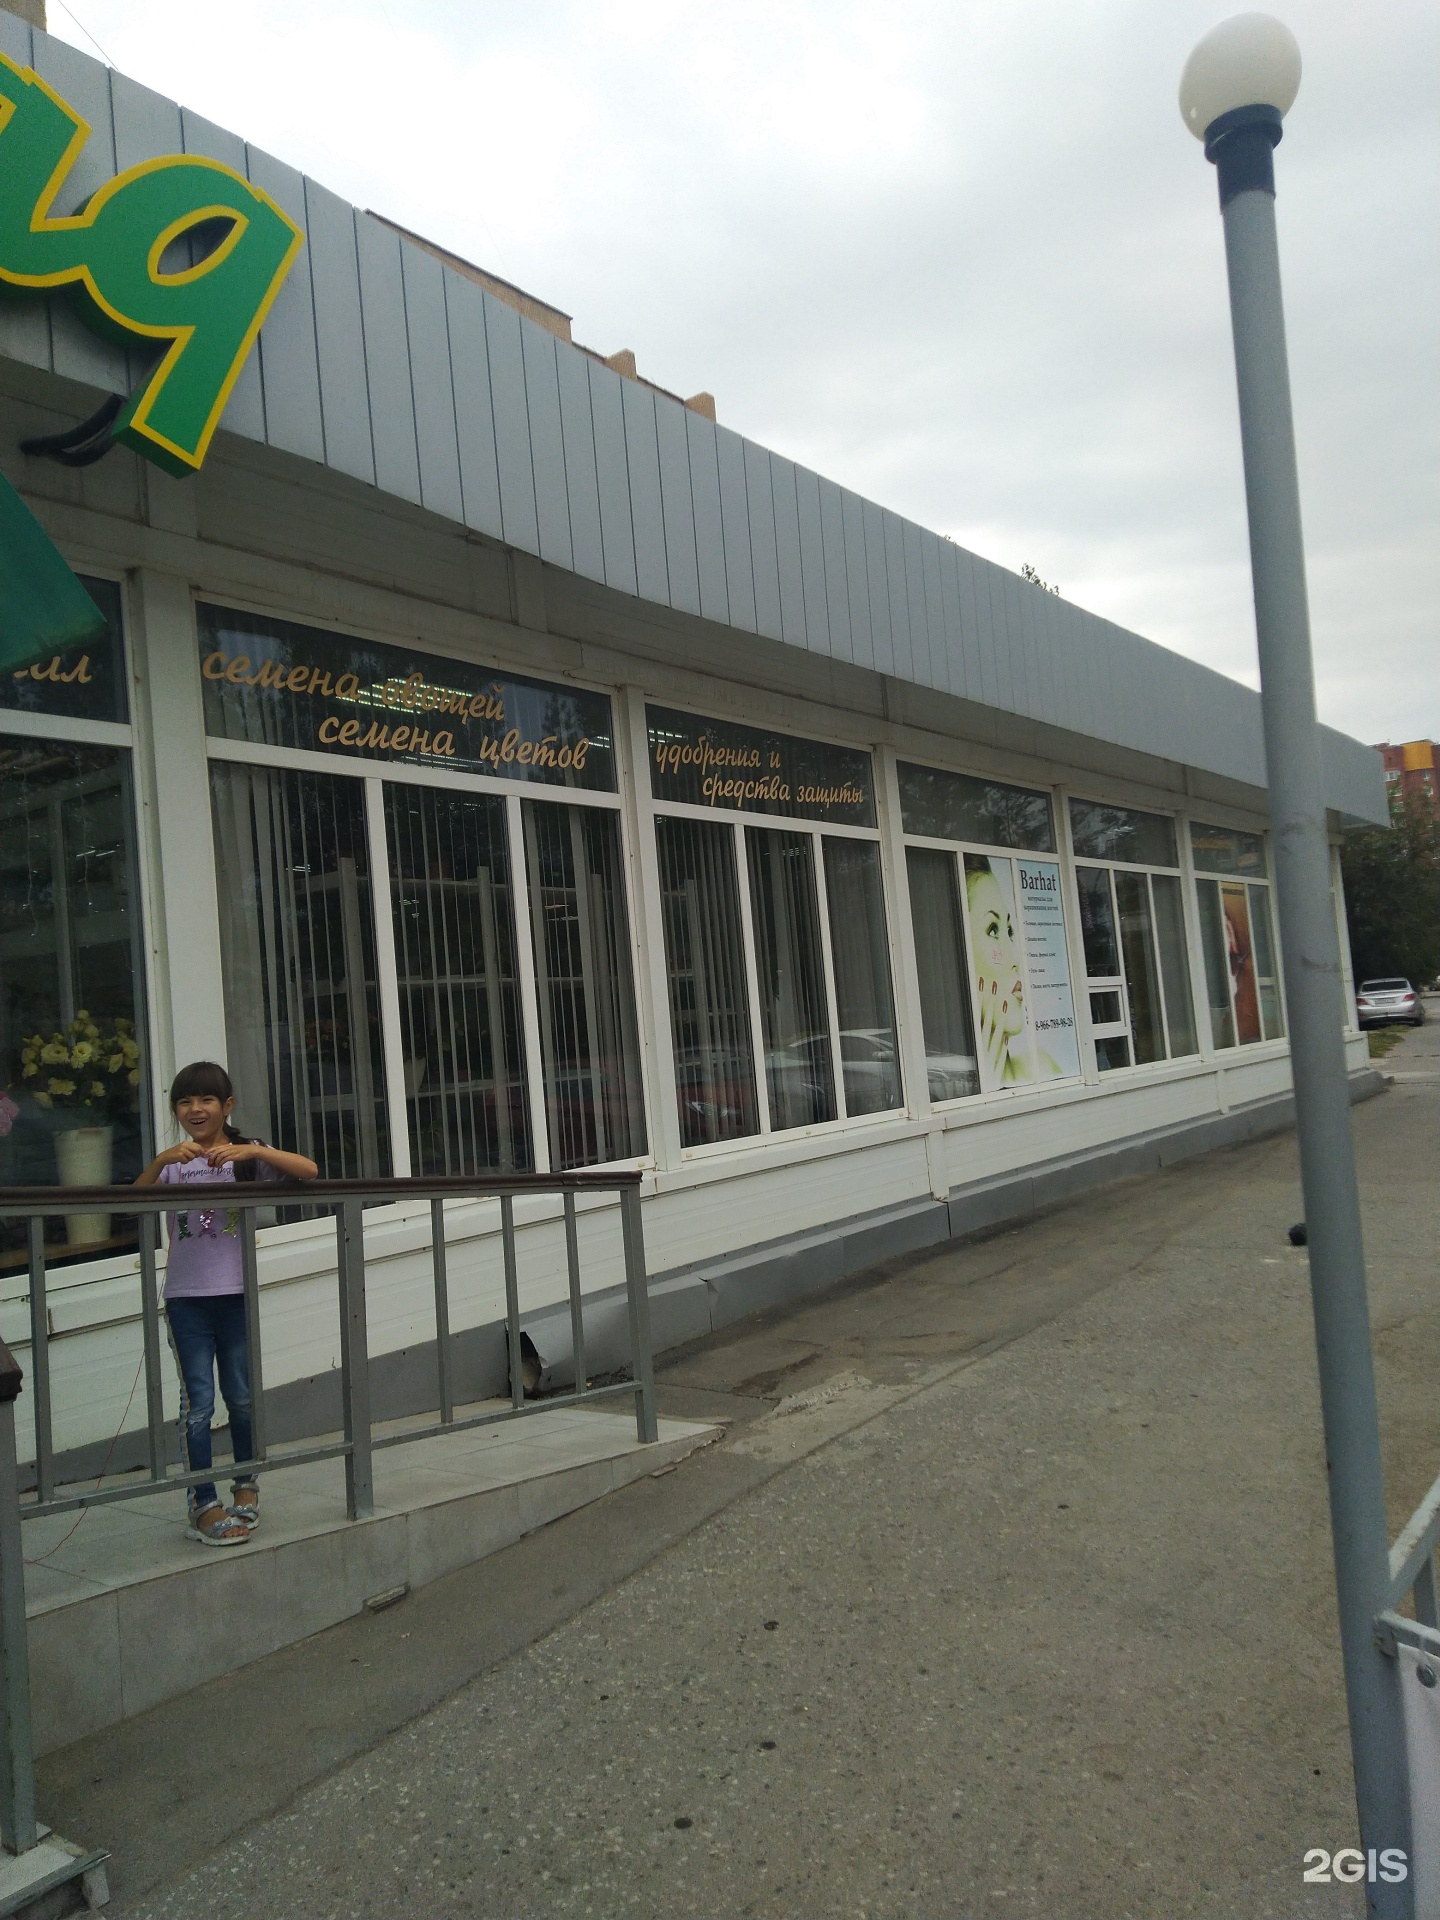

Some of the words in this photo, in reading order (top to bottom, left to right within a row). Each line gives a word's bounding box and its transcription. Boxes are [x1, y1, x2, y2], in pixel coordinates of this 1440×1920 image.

[202, 650, 361, 701] семена
[381, 672, 505, 725] овощей
[318, 716, 456, 757] семена
[479, 729, 590, 770] цветов
[655, 735, 761, 775] удобрения
[769, 750, 781, 769] и
[702, 773, 791, 807] средства
[796, 781, 864, 808] защиты
[1019, 869, 1057, 891] Barhat
